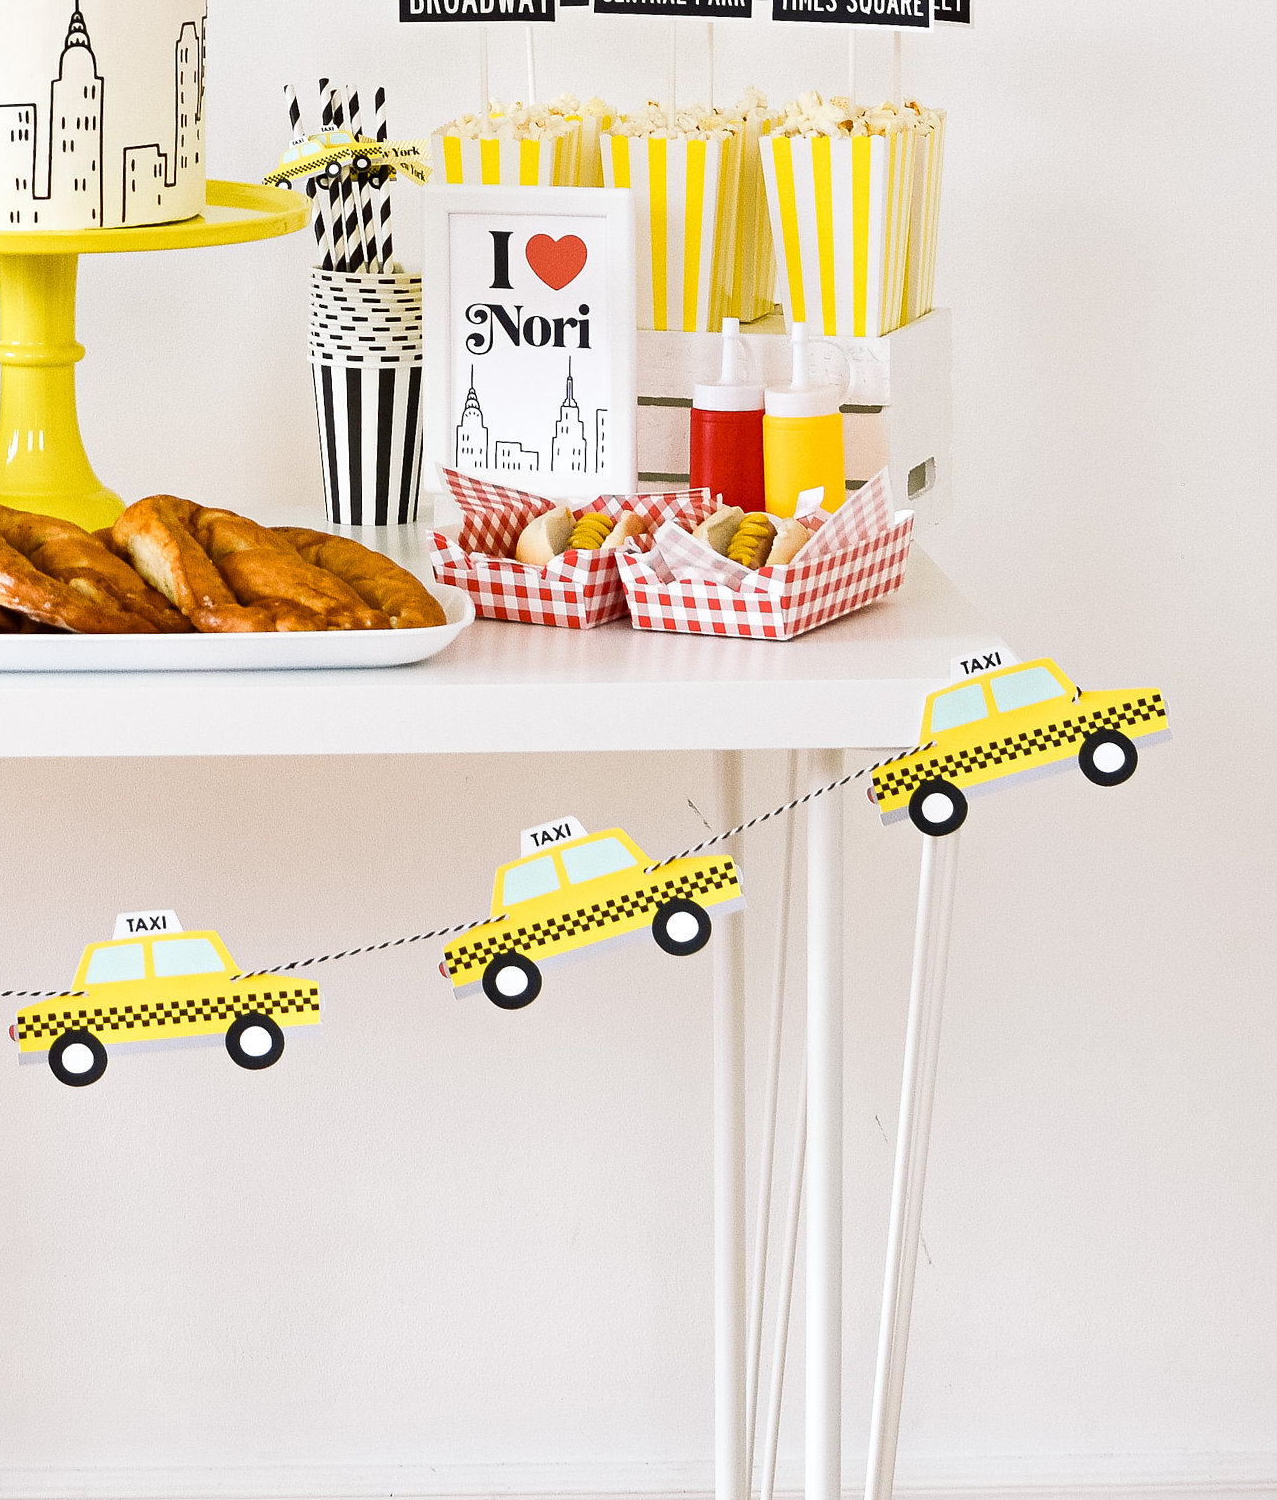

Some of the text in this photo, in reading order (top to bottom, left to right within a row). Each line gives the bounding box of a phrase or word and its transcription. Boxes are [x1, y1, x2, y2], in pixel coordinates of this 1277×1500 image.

[391, 146, 420, 158] York
[488, 230, 514, 290] I
[465, 303, 591, 355] Nori
[960, 652, 1001, 675] TAXI
[530, 823, 571, 847] TAXI
[126, 915, 166, 932] TAXI
